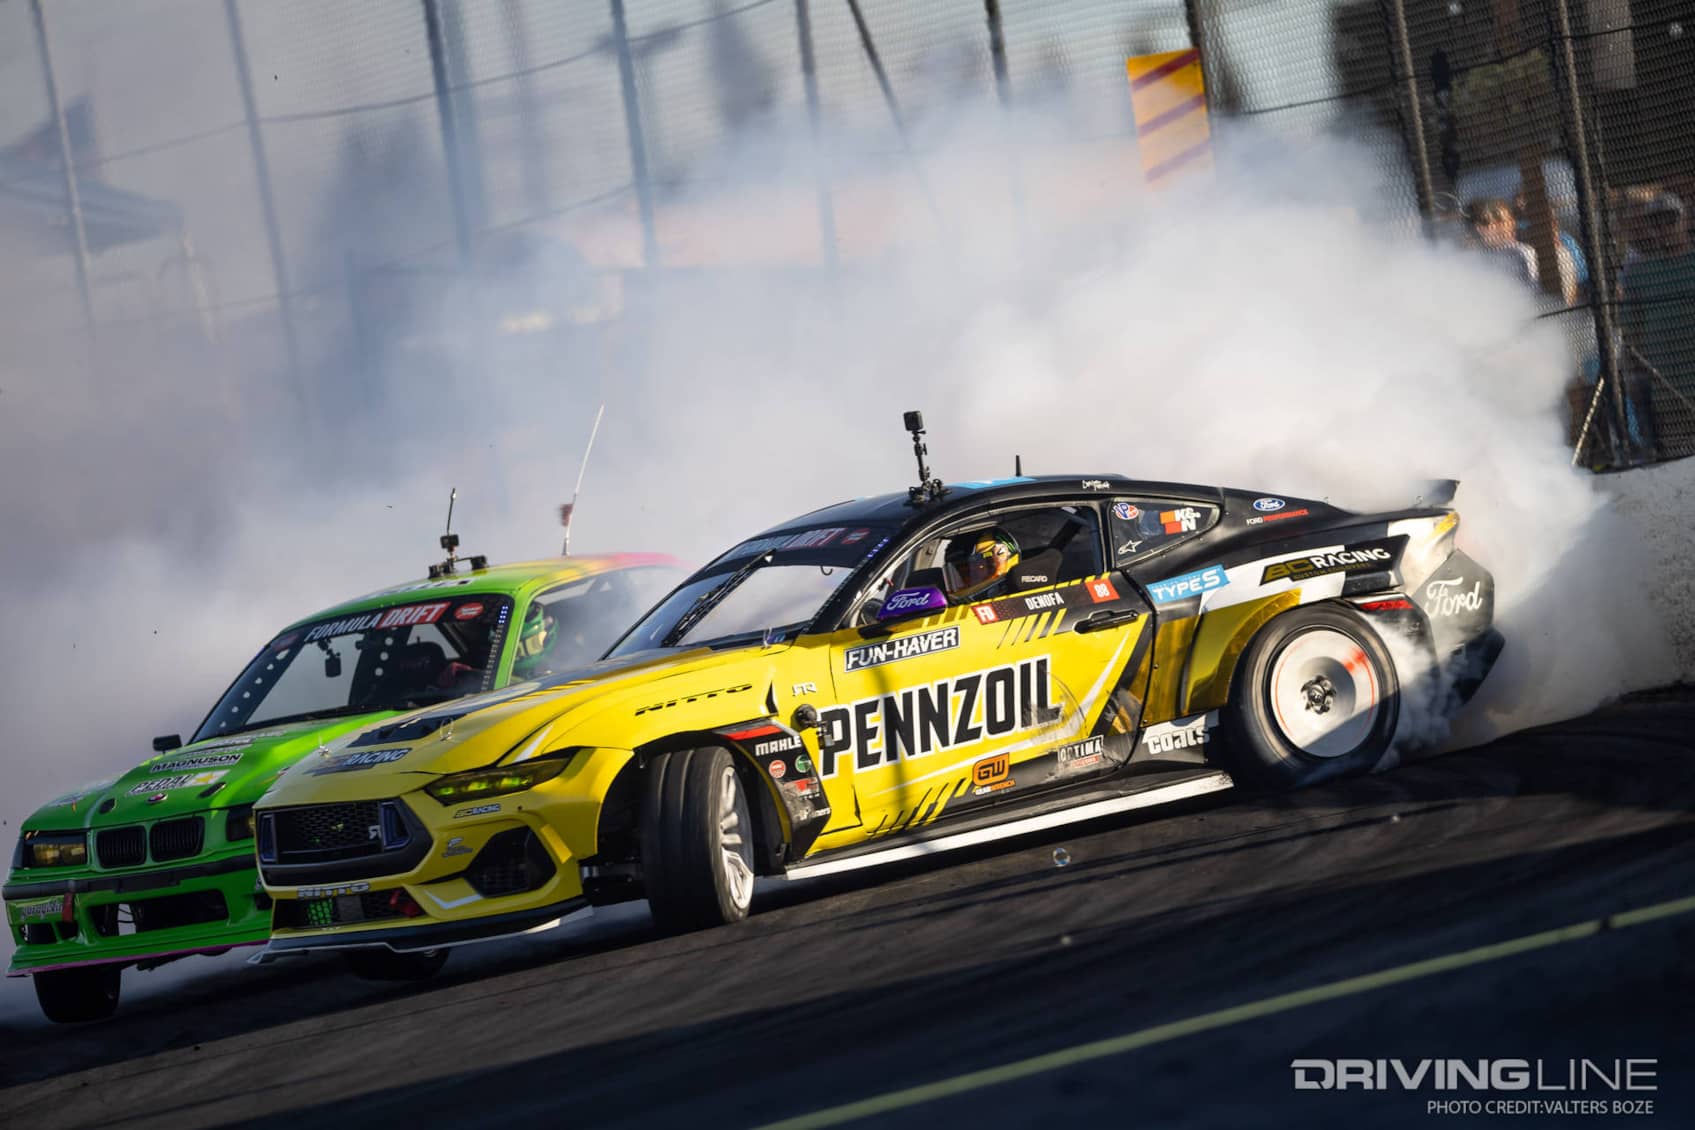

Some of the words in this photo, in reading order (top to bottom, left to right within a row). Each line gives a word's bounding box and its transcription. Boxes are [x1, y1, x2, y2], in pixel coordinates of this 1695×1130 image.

[1309, 548, 1391, 569] RACING
[886, 591, 930, 610] Ford
[1025, 591, 1065, 610] DENOFA
[1424, 576, 1484, 617] Ford
[304, 612, 383, 642] FORMULA
[380, 603, 446, 625] DRIFT
[846, 628, 958, 671] FUN-HAVER
[818, 656, 1065, 779] PENNZOIL
[755, 735, 802, 757] MAHLE
[152, 753, 242, 772] MAGNUSON
